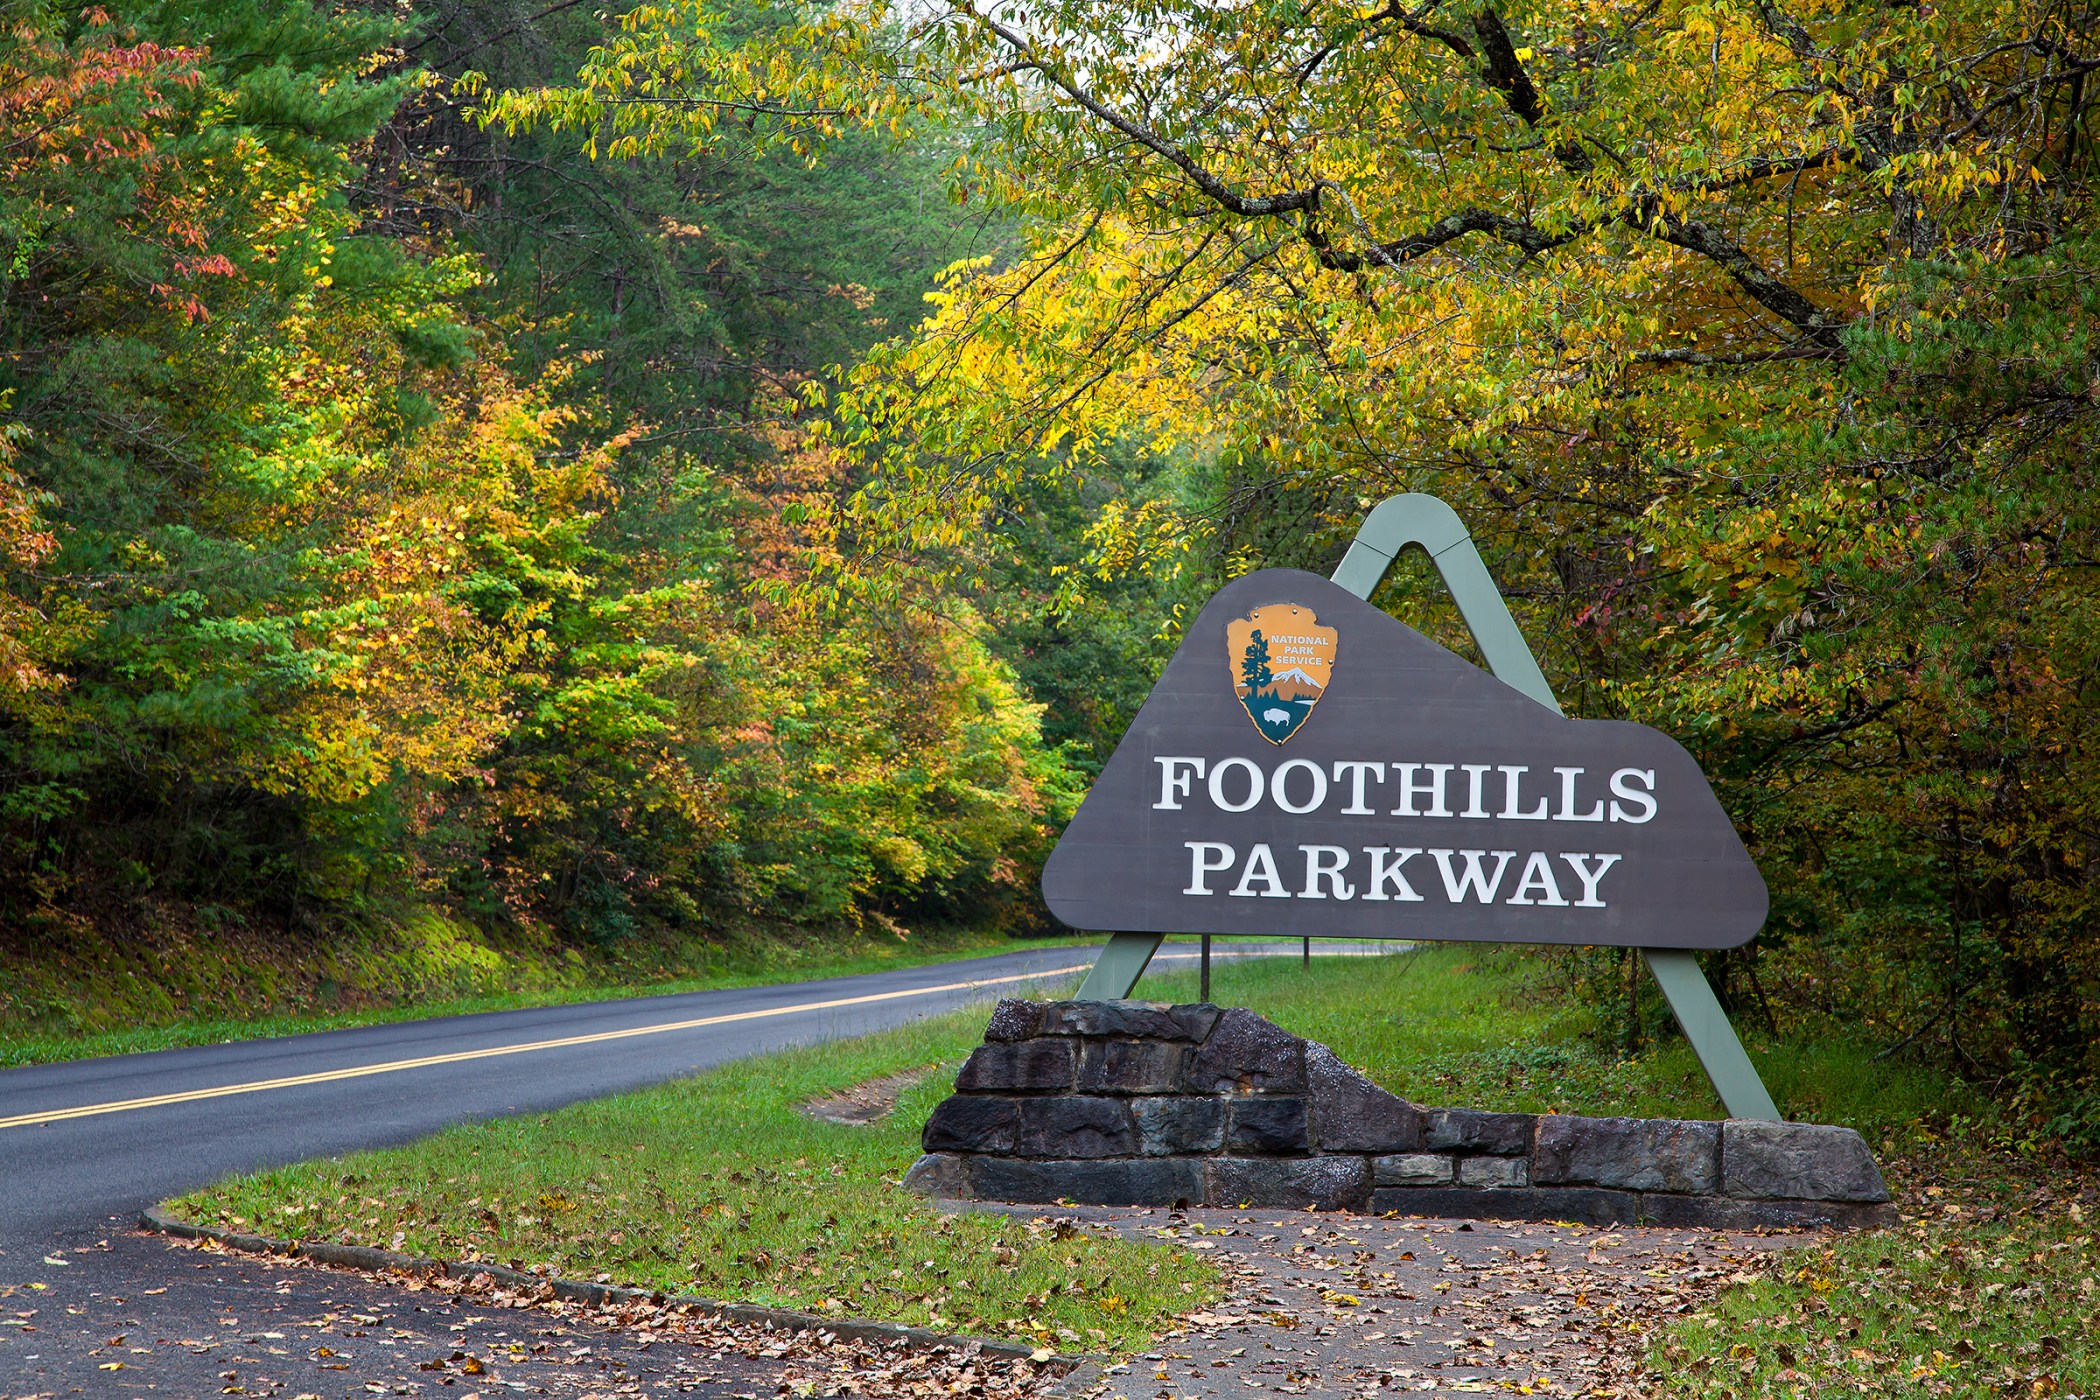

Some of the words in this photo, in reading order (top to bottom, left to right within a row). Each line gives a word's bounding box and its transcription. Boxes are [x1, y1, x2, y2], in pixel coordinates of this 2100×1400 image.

[1271, 635, 1328, 645] NATIONAL
[1284, 646, 1314, 655] PARK
[1275, 656, 1322, 666] SERVICE
[1152, 756, 1657, 824] FOOTHILLS
[1182, 841, 1622, 908] PARKWAY
